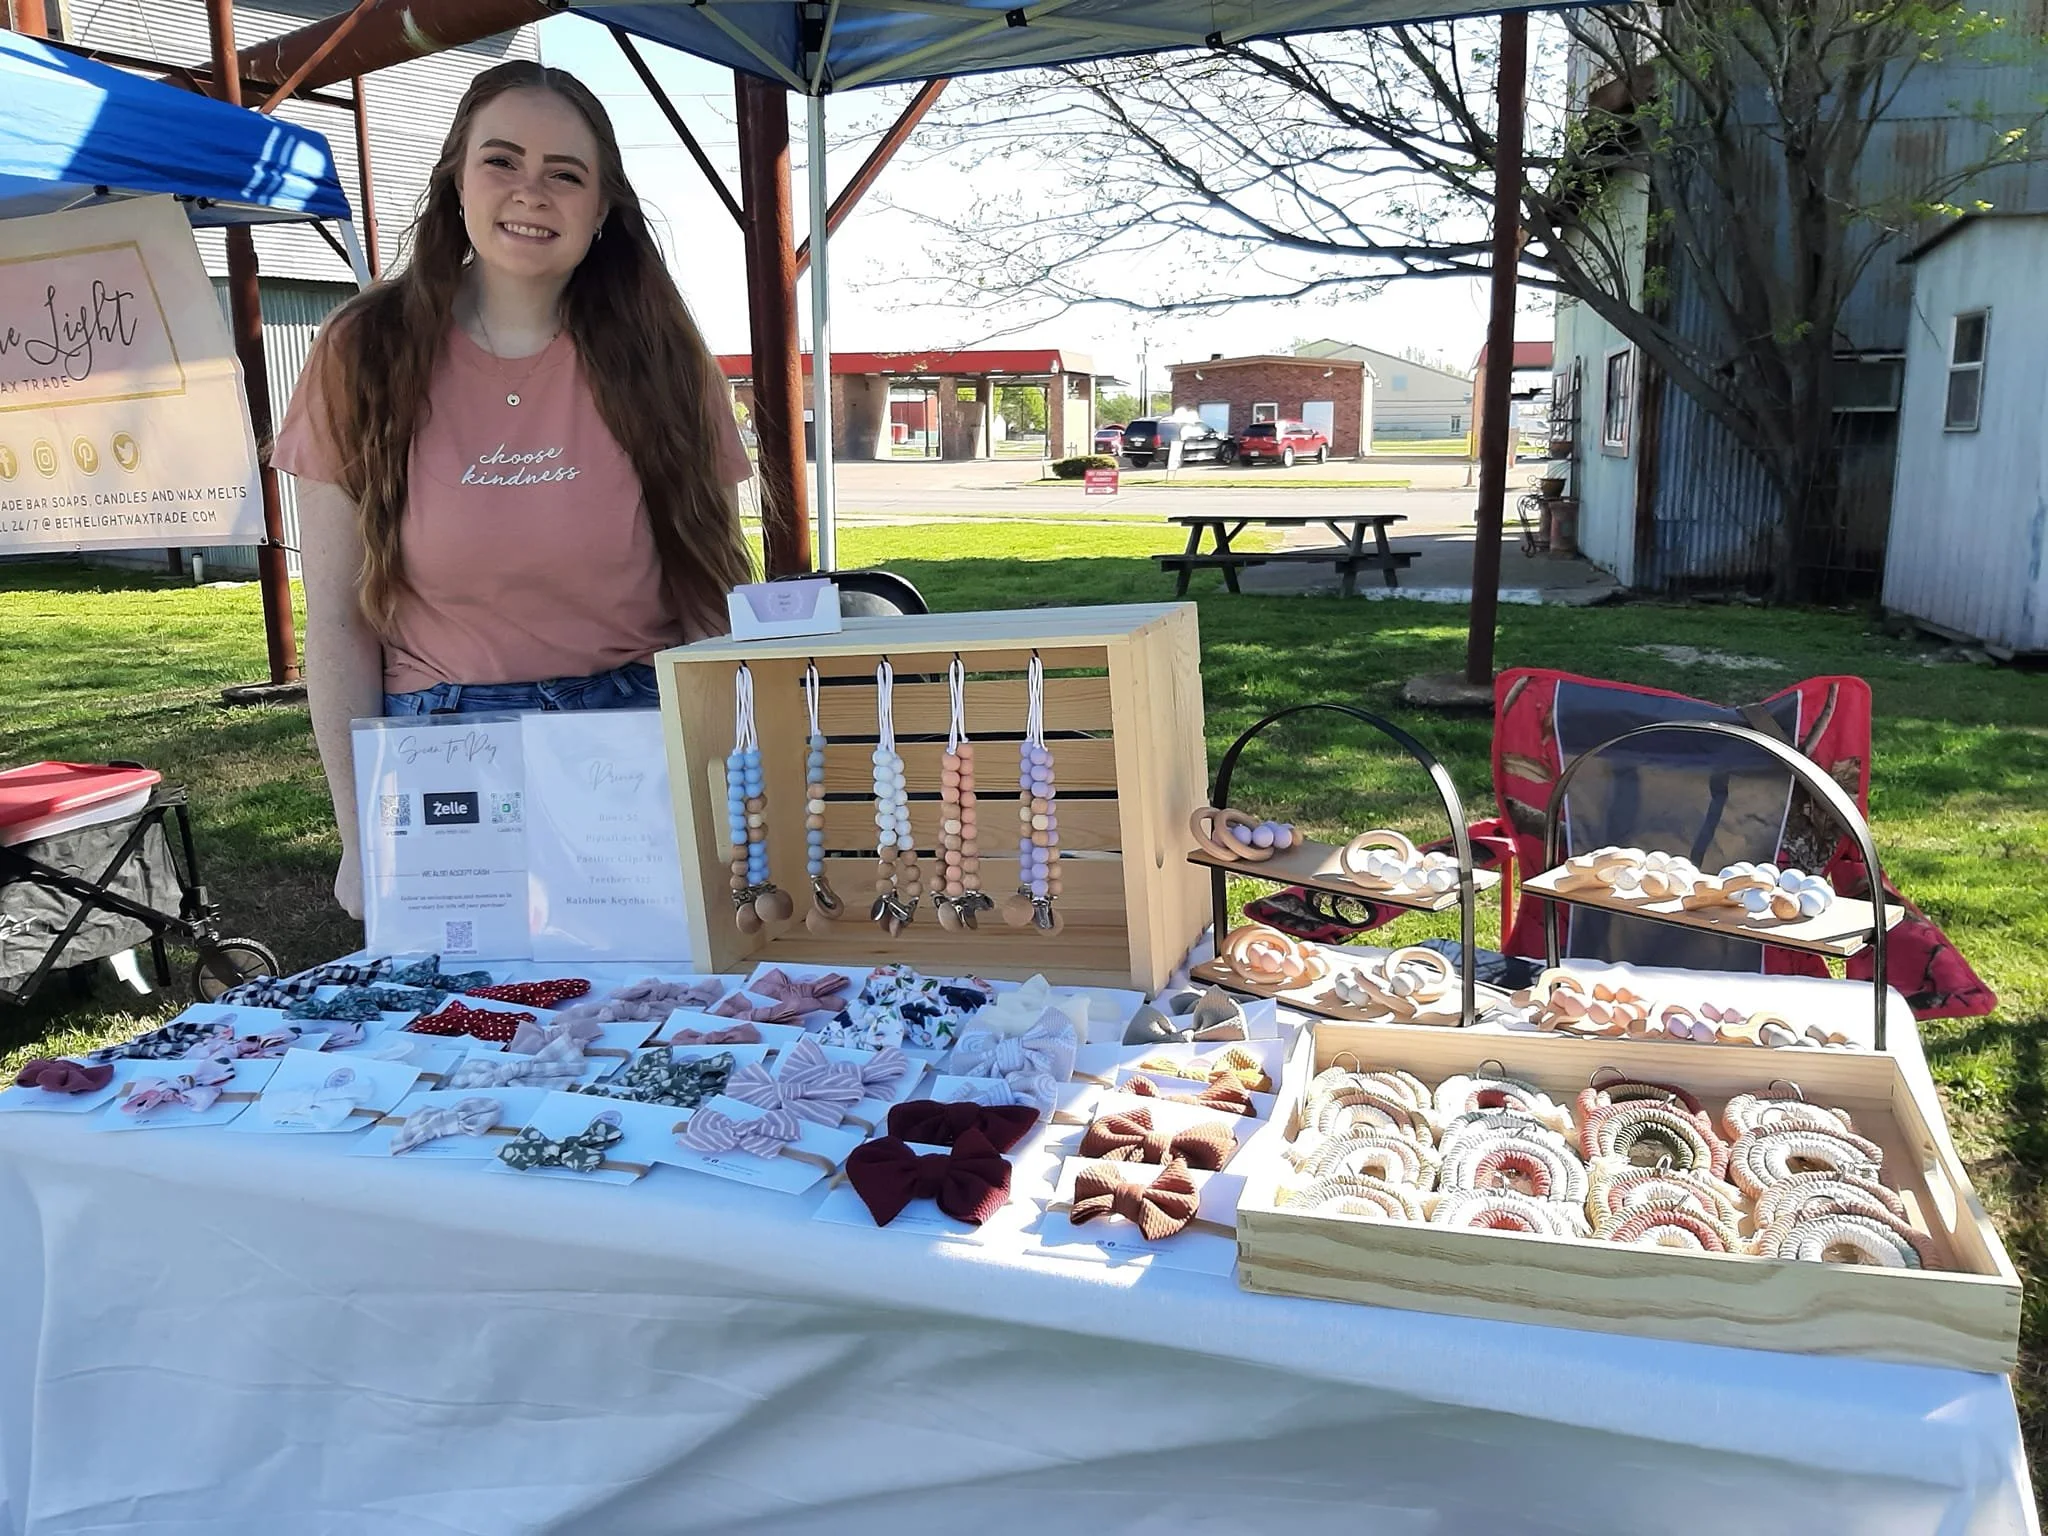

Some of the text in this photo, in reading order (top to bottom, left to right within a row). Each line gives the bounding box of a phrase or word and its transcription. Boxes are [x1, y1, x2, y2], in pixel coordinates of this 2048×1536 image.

[25, 280, 137, 381] Light
[22, 375, 71, 392] TRADE
[479, 443, 564, 465] choose
[461, 464, 581, 486] kindness
[26, 498, 48, 510] BAR
[94, 491, 147, 506] CANDLES
[151, 490, 175, 503] AND
[176, 488, 203, 502] WAX
[207, 486, 247, 500] MELTS
[41, 517, 51, 530] @
[464, 731, 497, 764] Pay
[432, 800, 468, 817] Zelle
